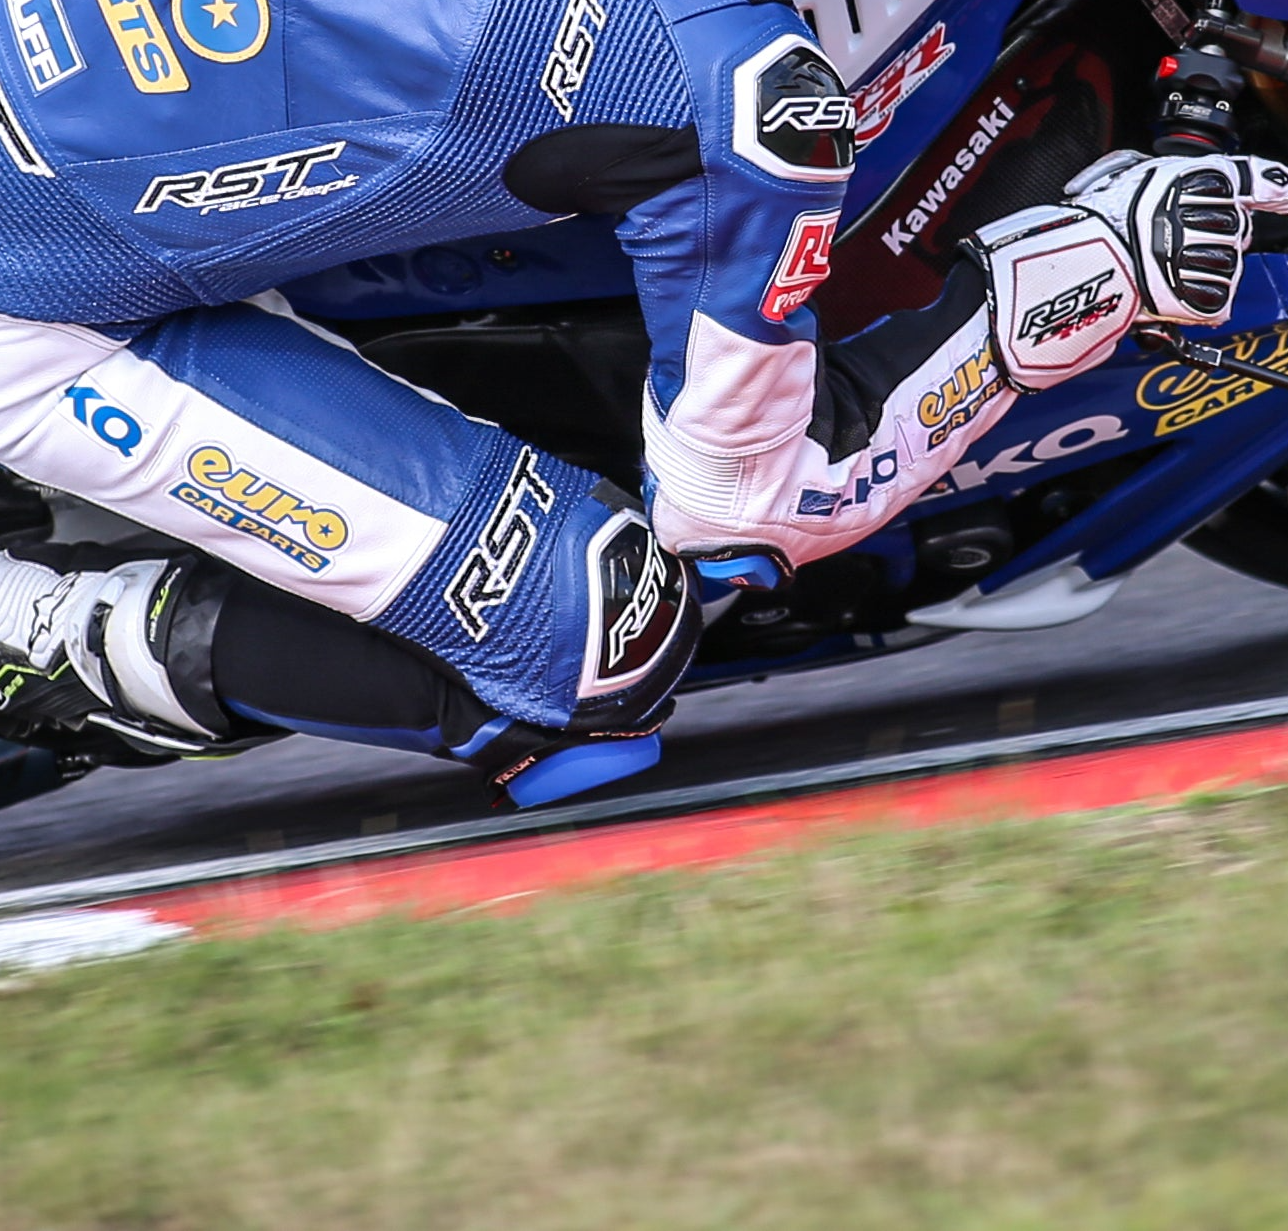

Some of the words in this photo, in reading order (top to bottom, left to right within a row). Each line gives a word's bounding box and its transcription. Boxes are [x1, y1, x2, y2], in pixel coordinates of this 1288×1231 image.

[132, 140, 347, 215] RST
[199, 192, 280, 216] race
[281, 174, 360, 201] dept
[880, 96, 1017, 257] Kawasaki
[1015, 267, 1115, 341] RST
[63, 385, 143, 458] KQ
[916, 344, 997, 427] eur
[1165, 379, 1258, 429] CAR
[186, 435, 349, 552] euro
[913, 413, 1131, 503] KQ
[177, 486, 235, 523] CAR
[236, 519, 324, 572] PARTS
[442, 444, 556, 644] RST
[606, 528, 669, 670] RST
